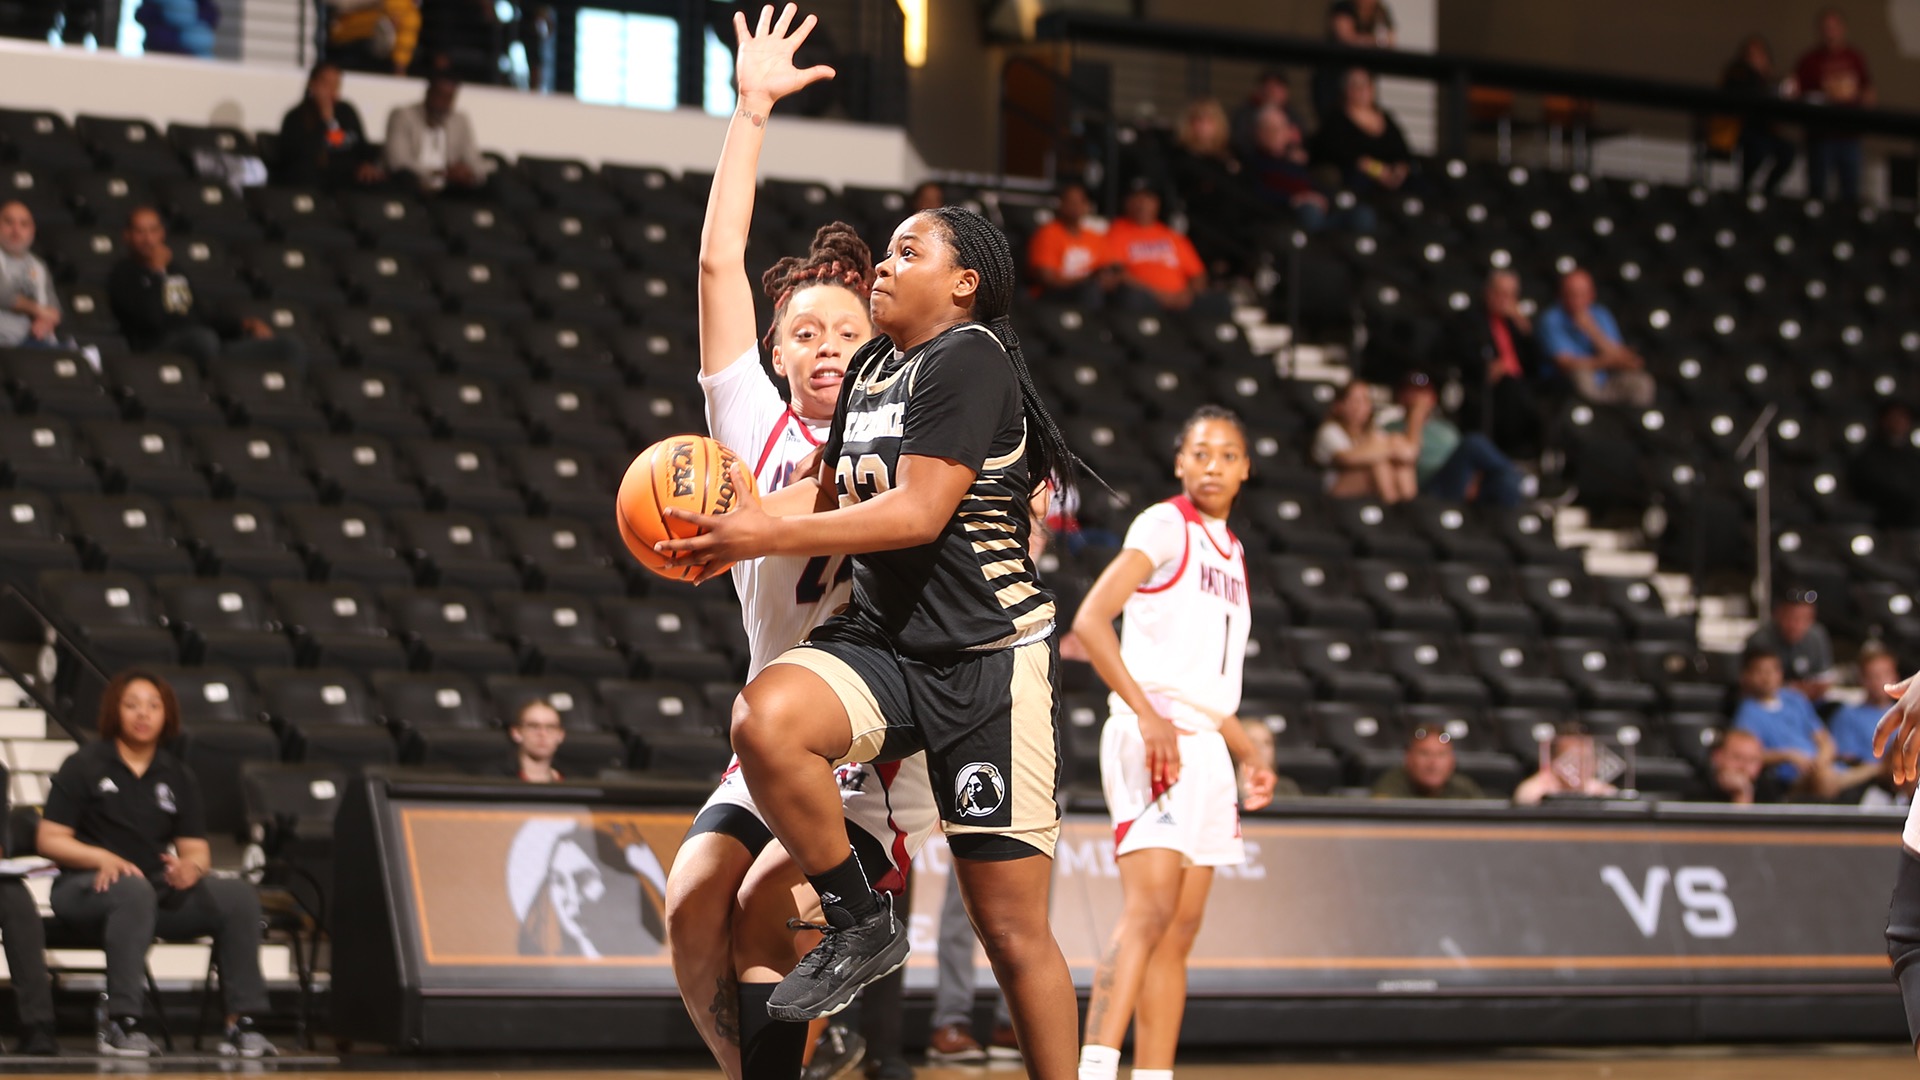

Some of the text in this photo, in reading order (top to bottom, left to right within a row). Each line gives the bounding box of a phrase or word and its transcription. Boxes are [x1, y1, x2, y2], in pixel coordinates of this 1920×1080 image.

[673, 441, 694, 497] NCAA
[1220, 613, 1230, 676] 1
[1600, 865, 1737, 938] VS
